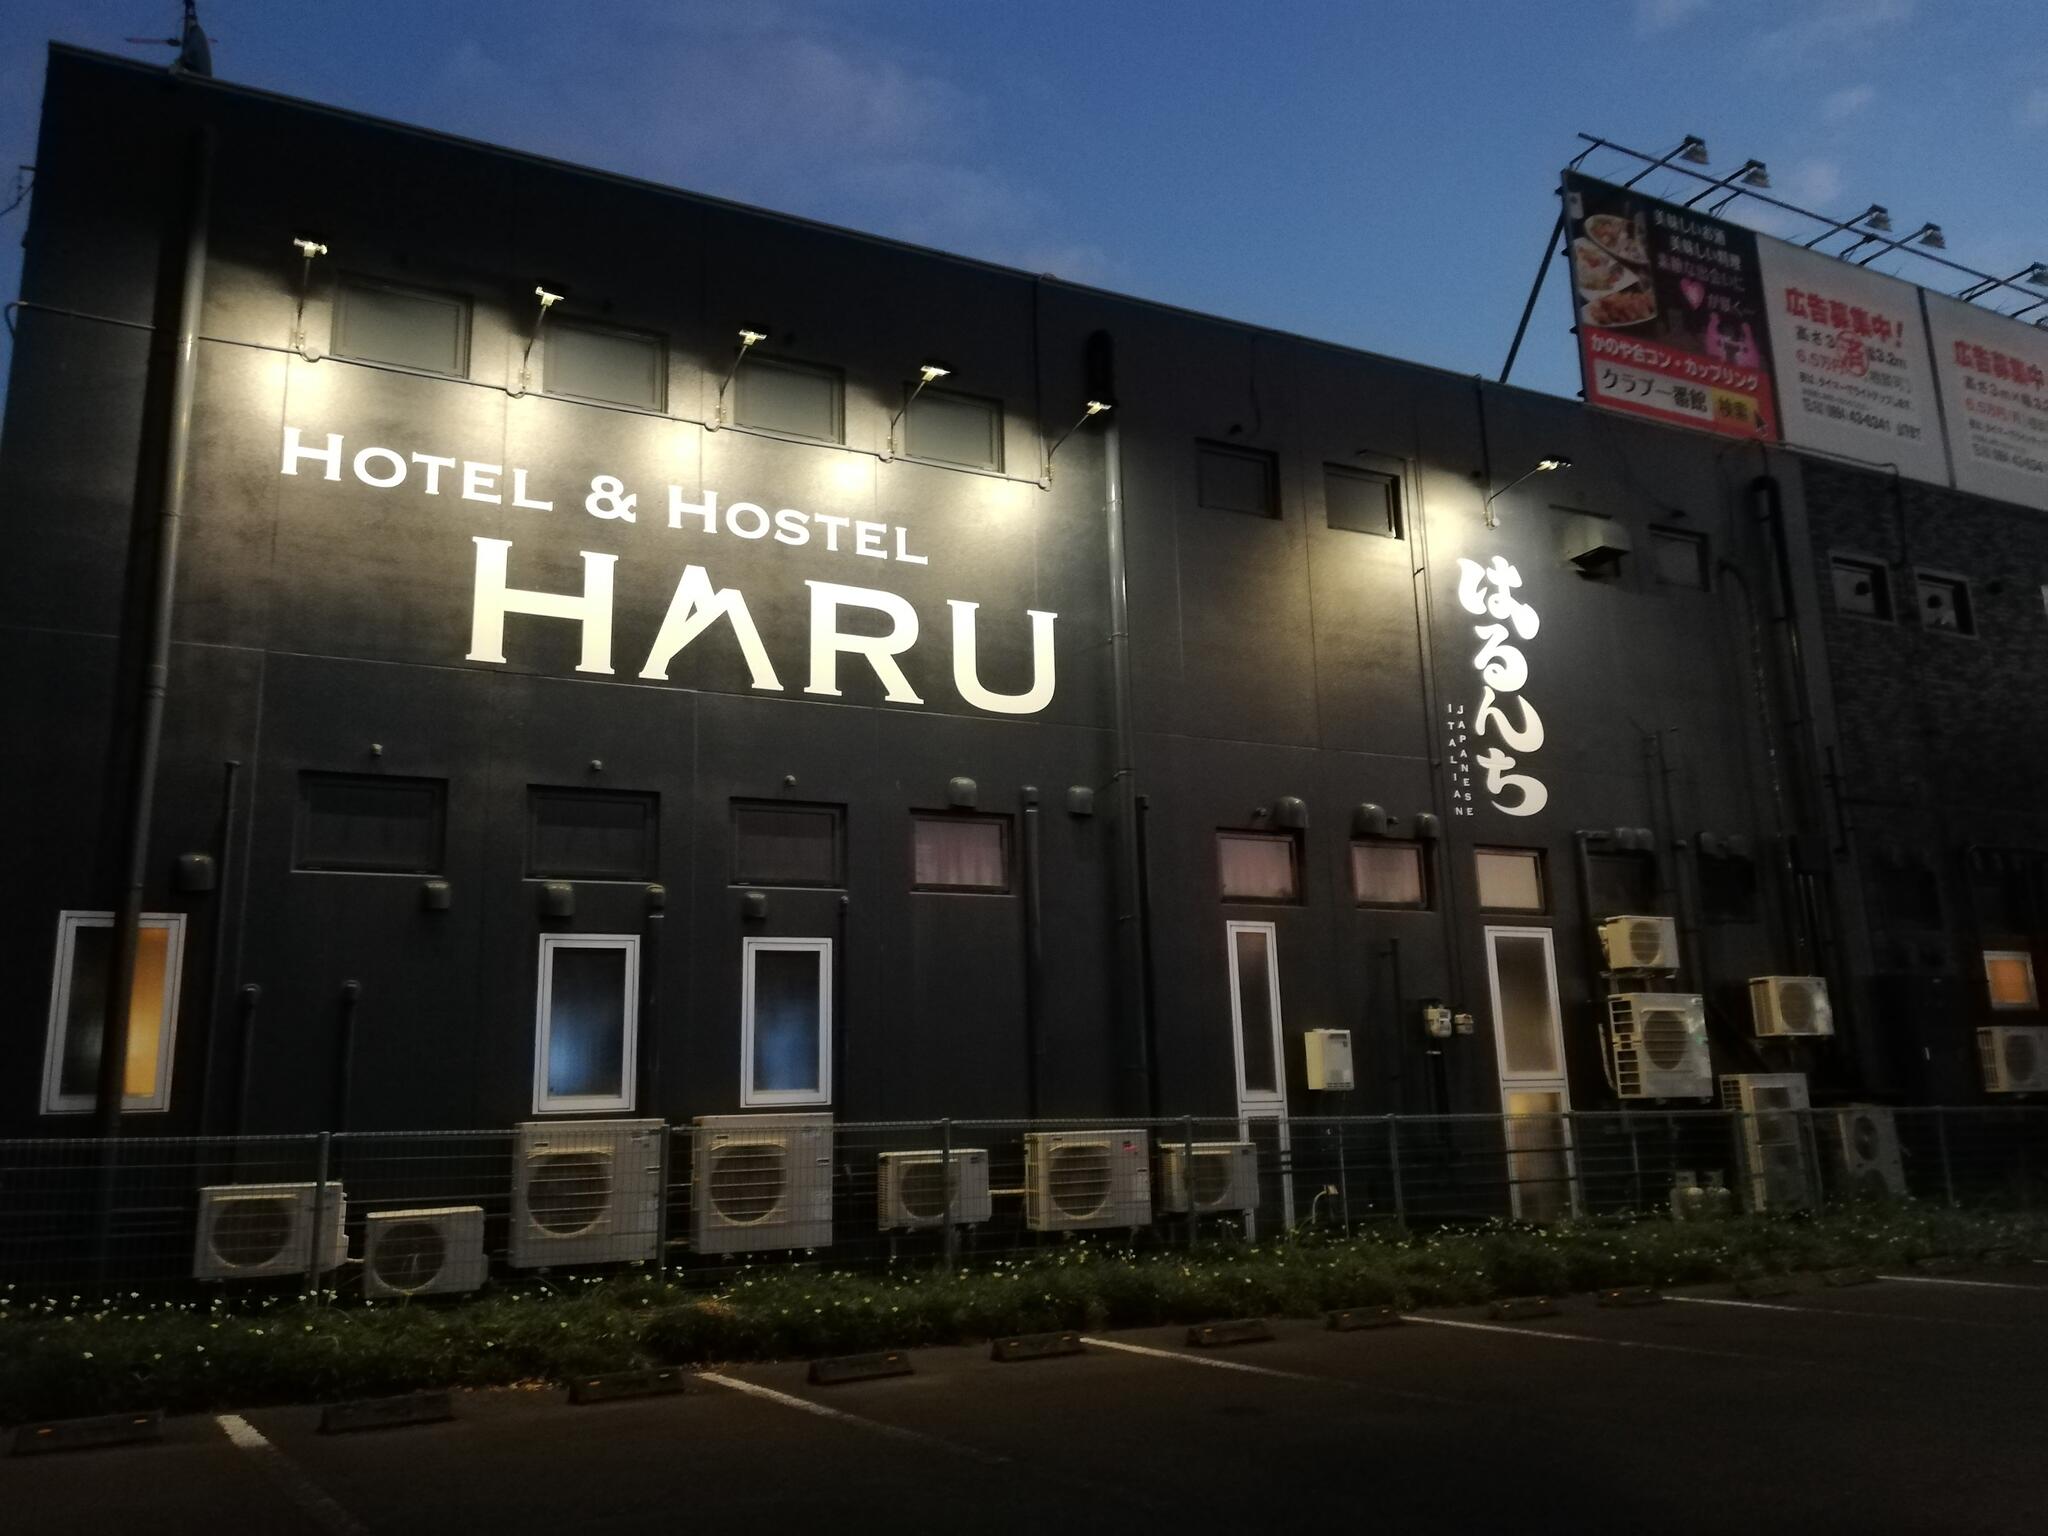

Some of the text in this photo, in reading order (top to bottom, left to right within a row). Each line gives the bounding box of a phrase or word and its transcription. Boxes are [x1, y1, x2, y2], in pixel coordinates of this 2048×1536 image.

[1602, 368, 1709, 413] クラブ一番館
[584, 474, 638, 524] &
[466, 536, 1058, 715] HARU
[1455, 555, 1548, 817] はるんち
[1447, 703, 1464, 816] ITALIAN
[1456, 705, 1474, 816] JAPANESE
